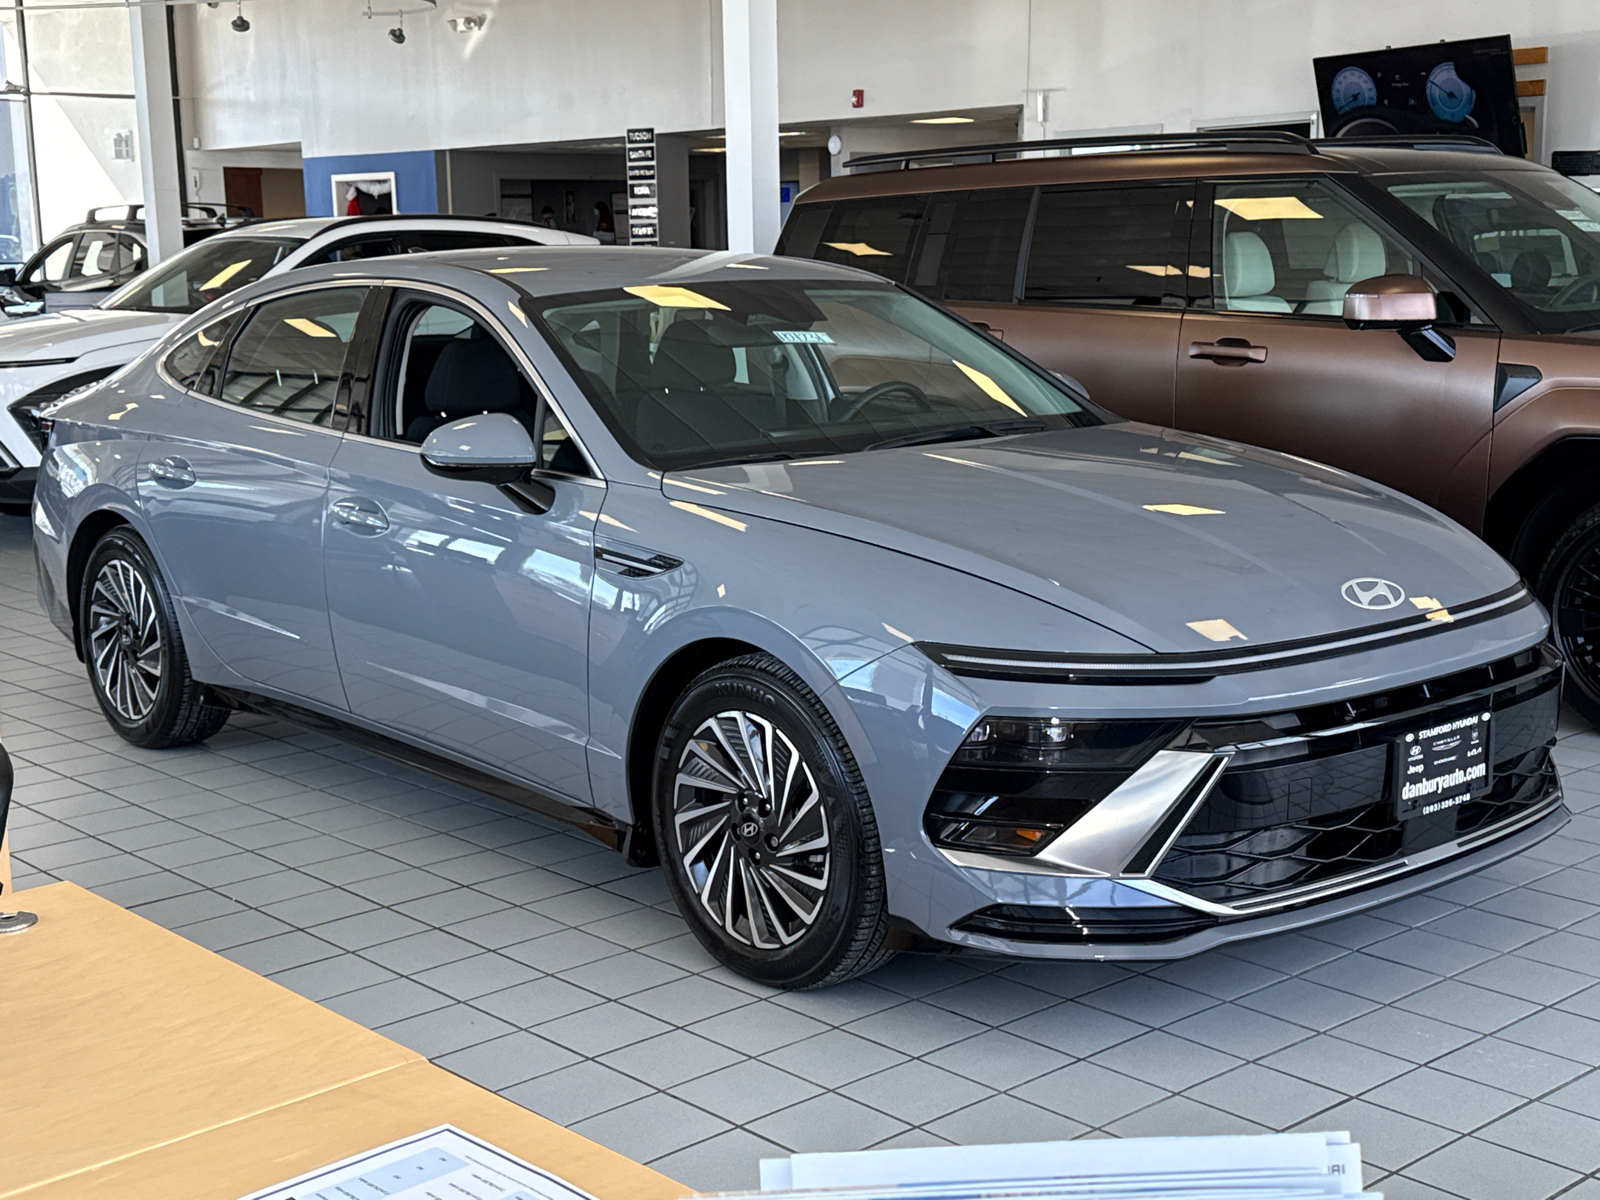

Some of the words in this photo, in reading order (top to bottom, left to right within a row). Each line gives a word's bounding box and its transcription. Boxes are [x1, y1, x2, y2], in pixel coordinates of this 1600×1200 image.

[629, 132, 652, 141] TUCSON
[715, 682, 776, 707] KUMHO
[1418, 723, 1452, 740] STAMFORD
[1452, 715, 1479, 730] HYUNDAI
[1402, 762, 1486, 800] danburyauto.com
[1407, 764, 1424, 775] Jeep
